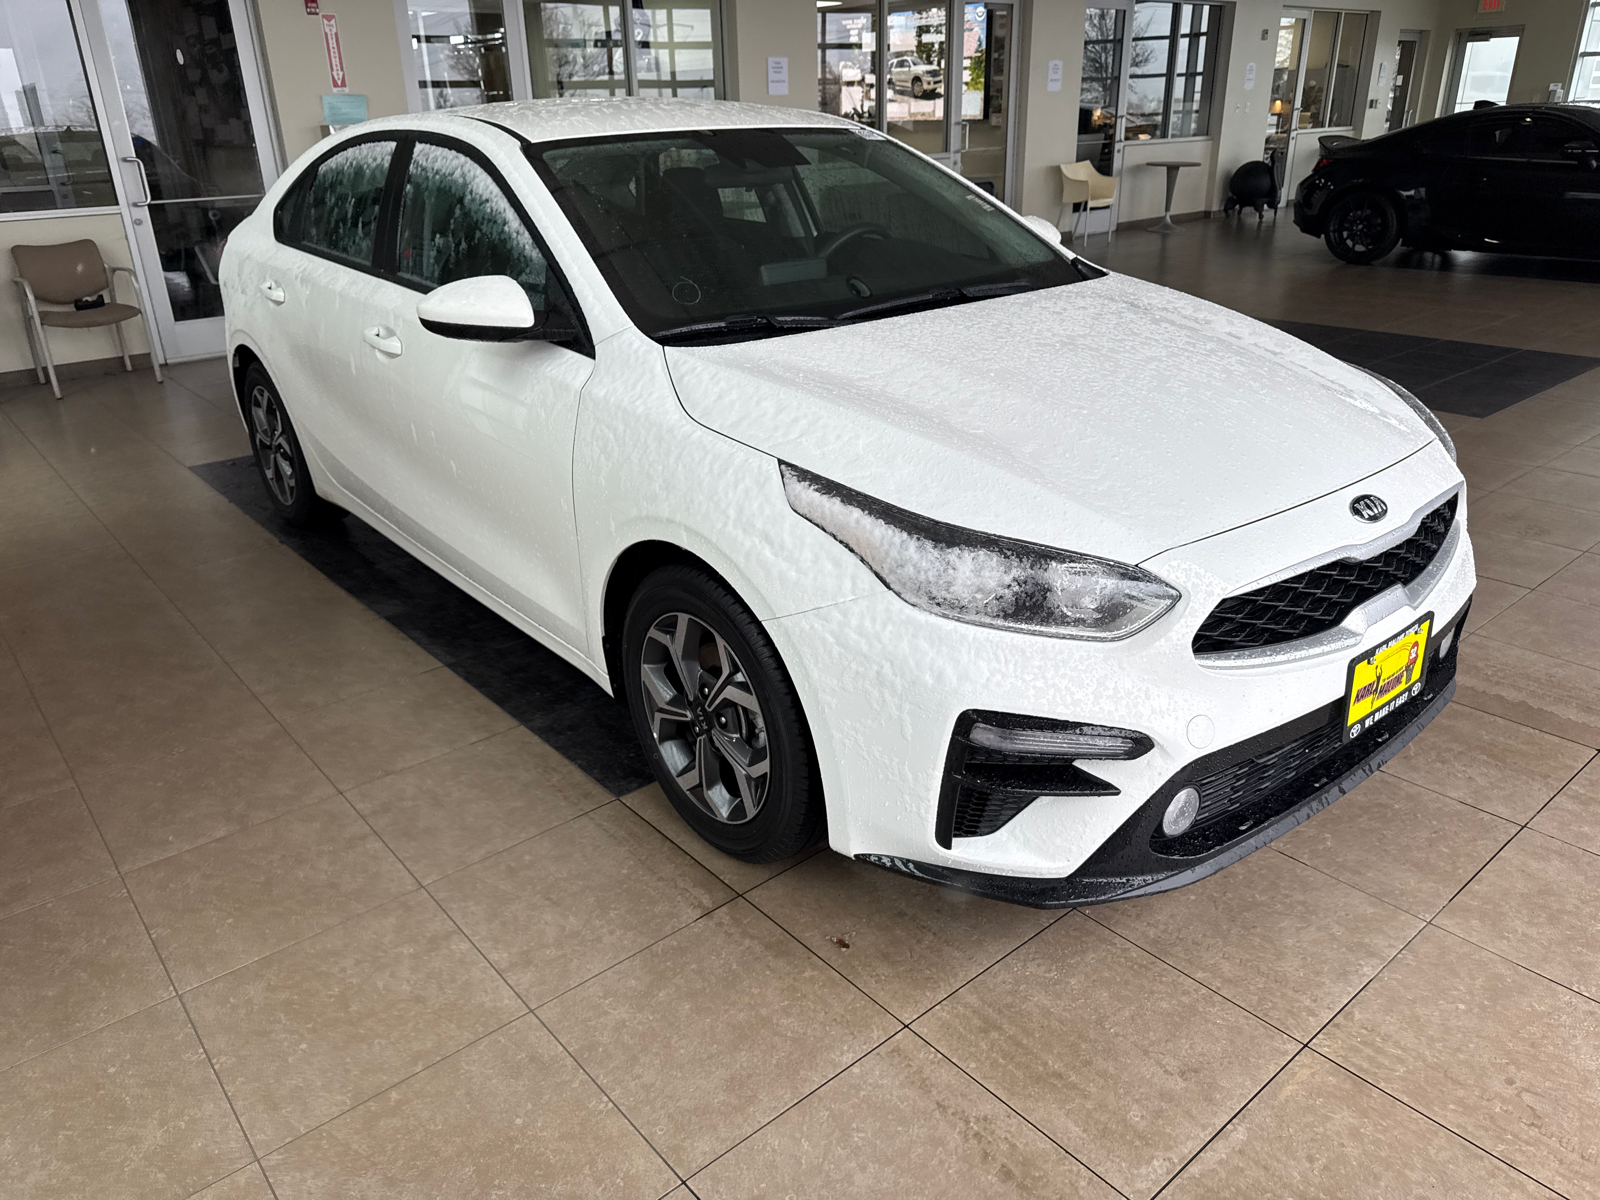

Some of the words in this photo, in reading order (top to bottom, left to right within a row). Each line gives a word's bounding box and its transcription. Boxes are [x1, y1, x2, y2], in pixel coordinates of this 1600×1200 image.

[1354, 496, 1387, 519] KIA
[1364, 715, 1374, 728] WE
[1374, 704, 1389, 722] MAKE
[1389, 700, 1396, 712] IT
[1395, 691, 1409, 708] EASY
